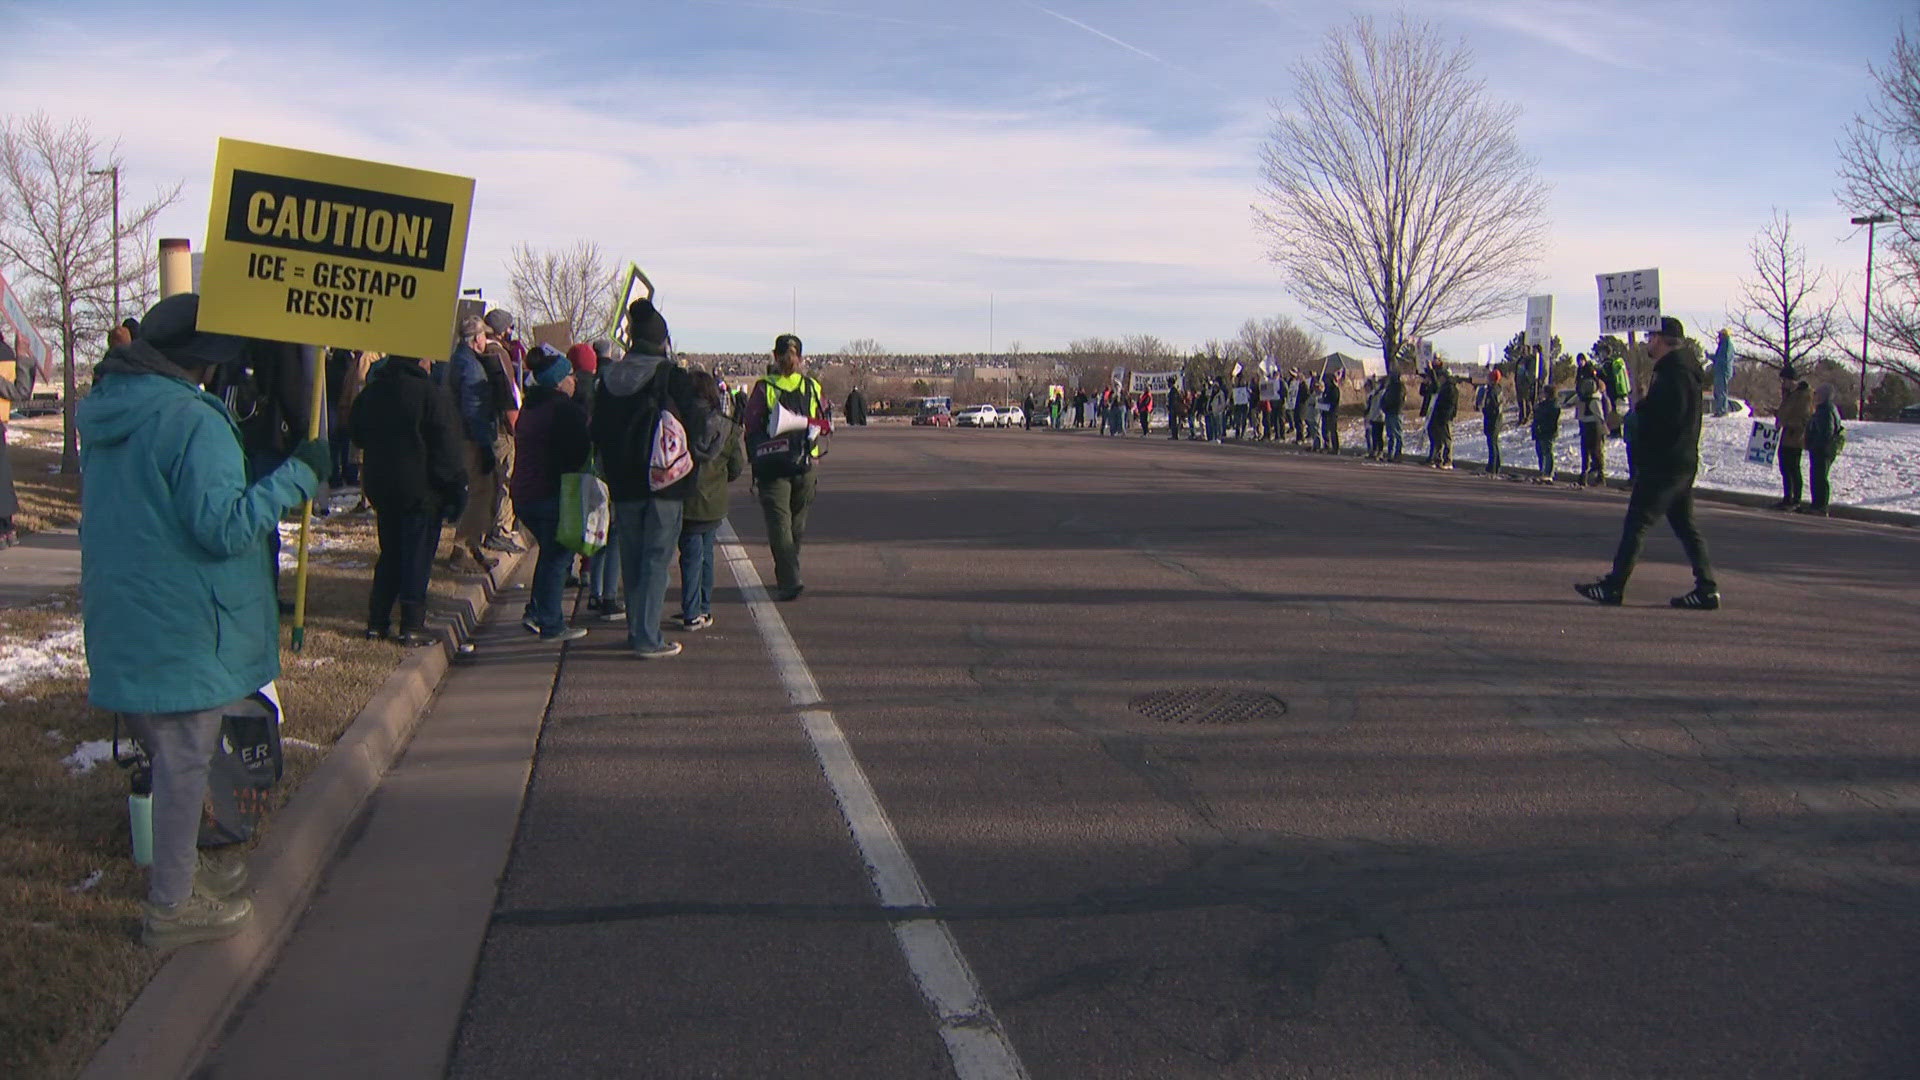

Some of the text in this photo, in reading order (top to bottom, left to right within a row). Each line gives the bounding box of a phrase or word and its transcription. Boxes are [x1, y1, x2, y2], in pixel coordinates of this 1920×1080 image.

[246, 191, 432, 259] CAUTION!
[248, 253, 287, 281] ICE
[313, 261, 417, 299] GESTAPO
[286, 288, 373, 323] RESIST!
[1602, 299, 1627, 311] STATE
